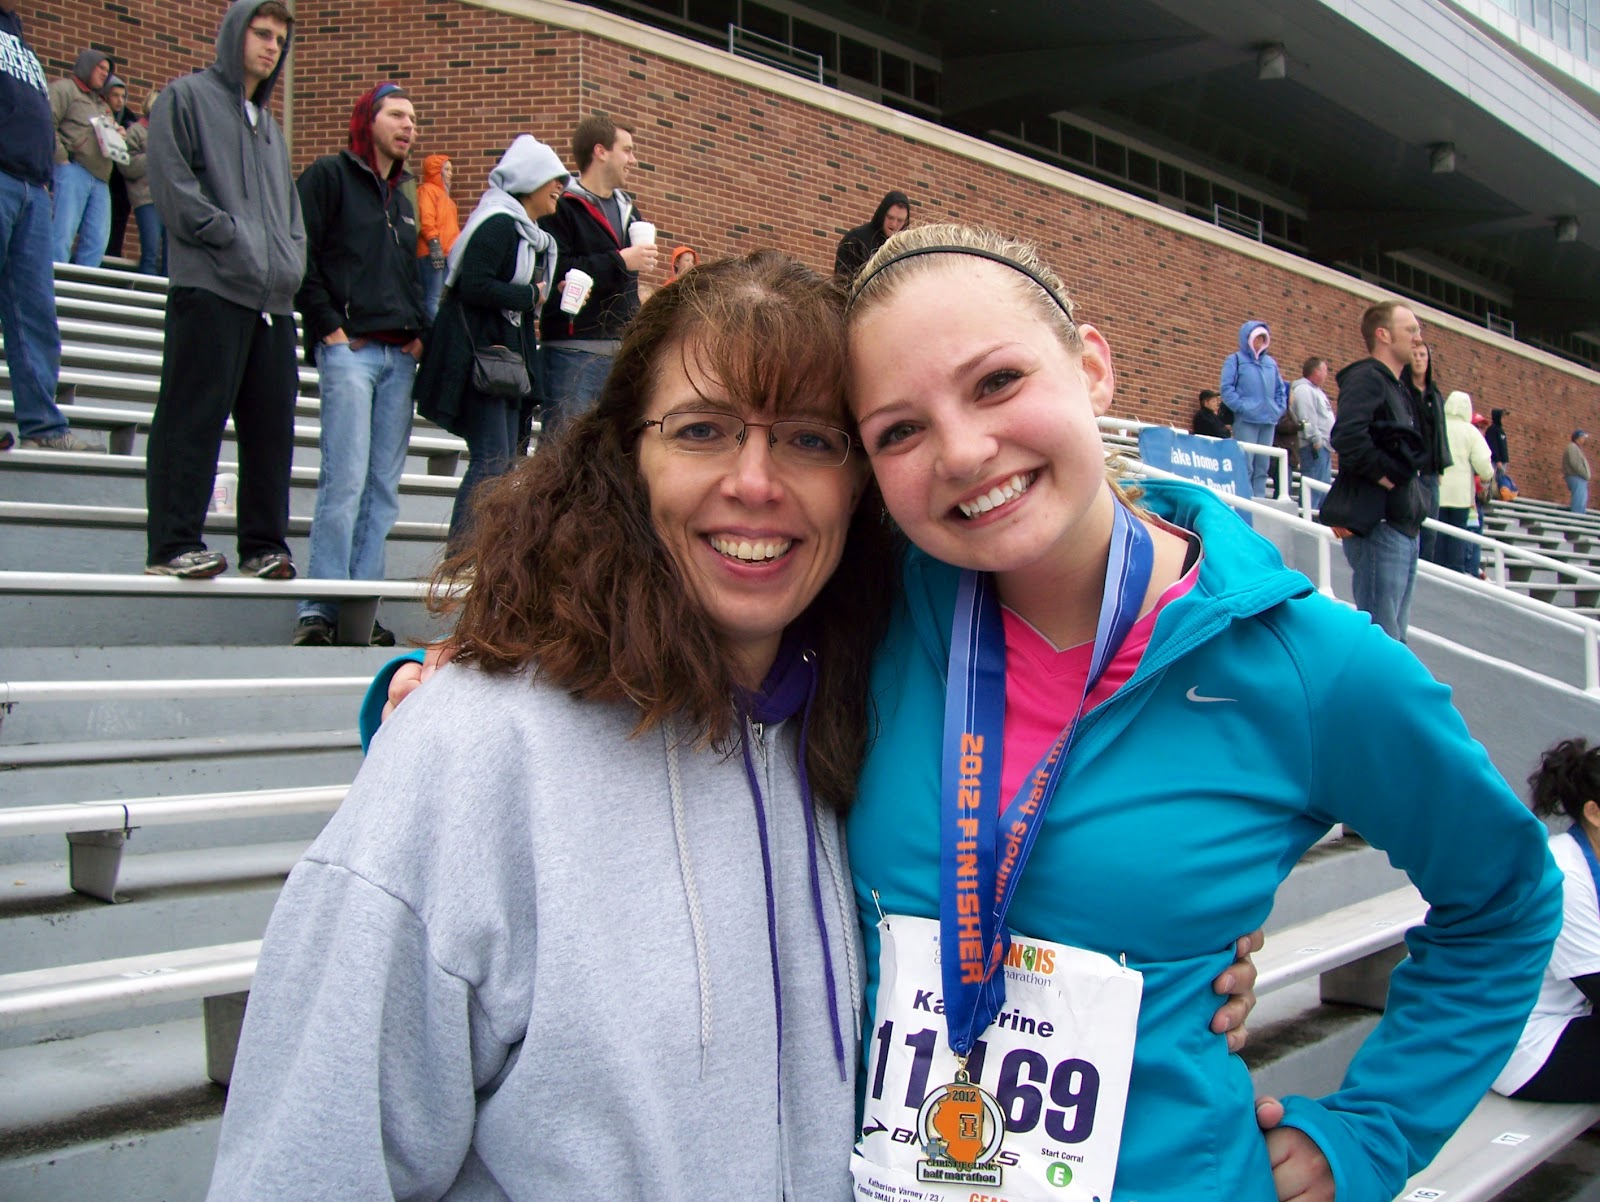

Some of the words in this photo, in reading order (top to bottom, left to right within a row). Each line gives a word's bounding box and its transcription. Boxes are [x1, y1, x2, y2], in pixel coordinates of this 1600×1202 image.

[1191, 451, 1219, 472] home
[1222, 458, 1233, 472] a
[958, 732, 984, 809] 2012
[956, 819, 984, 985] FINISHER
[913, 989, 1054, 1038] Karine
[952, 1090, 976, 1102] 2012
[1500, 1134, 1523, 1143] 17
[1041, 1147, 1060, 1159] Start
[1061, 1151, 1084, 1163] Corral
[923, 1168, 944, 1179] half
[944, 1171, 997, 1183] marathon
[1053, 1166, 1065, 1185] E
[857, 1183, 874, 1198] Female
[868, 1178, 897, 1194] Katherine
[898, 1187, 924, 1200] Varney
[929, 1193, 939, 1202] 23
[1414, 1190, 1440, 1200] 16
